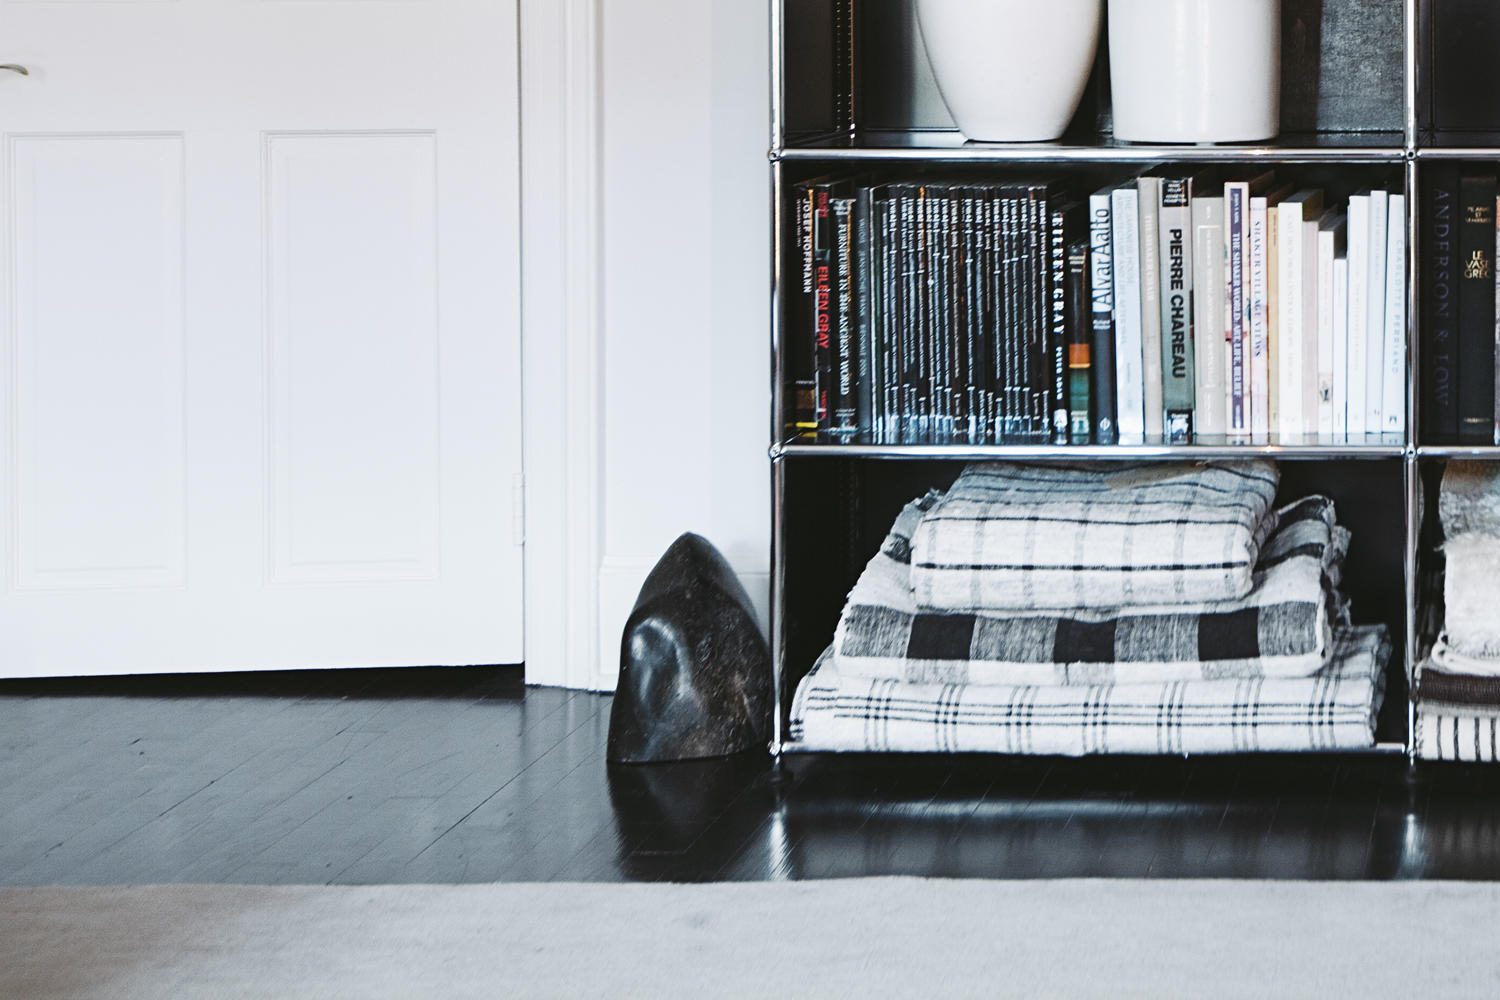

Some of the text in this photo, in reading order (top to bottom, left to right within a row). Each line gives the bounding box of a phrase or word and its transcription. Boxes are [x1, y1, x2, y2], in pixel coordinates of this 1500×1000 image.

[802, 198, 812, 293] JOSEF HOFFMANN
[1051, 216, 1064, 335] EILEEN GRAY
[1091, 208, 1110, 255] Aalto
[1232, 232, 1240, 249] THE
[1232, 251, 1241, 285] SHAKER
[1472, 250, 1484, 260] LE
[818, 266, 828, 349] EILEEN GRAY
[839, 223, 849, 395] FURNITURE IN THE ANCIENT WORLD
[1170, 229, 1185, 379] PIERRE CHAREAU
[1391, 239, 1404, 374] CHARLOTTE PERRIAND
[1434, 189, 1449, 407] ANDERSON & LOW
